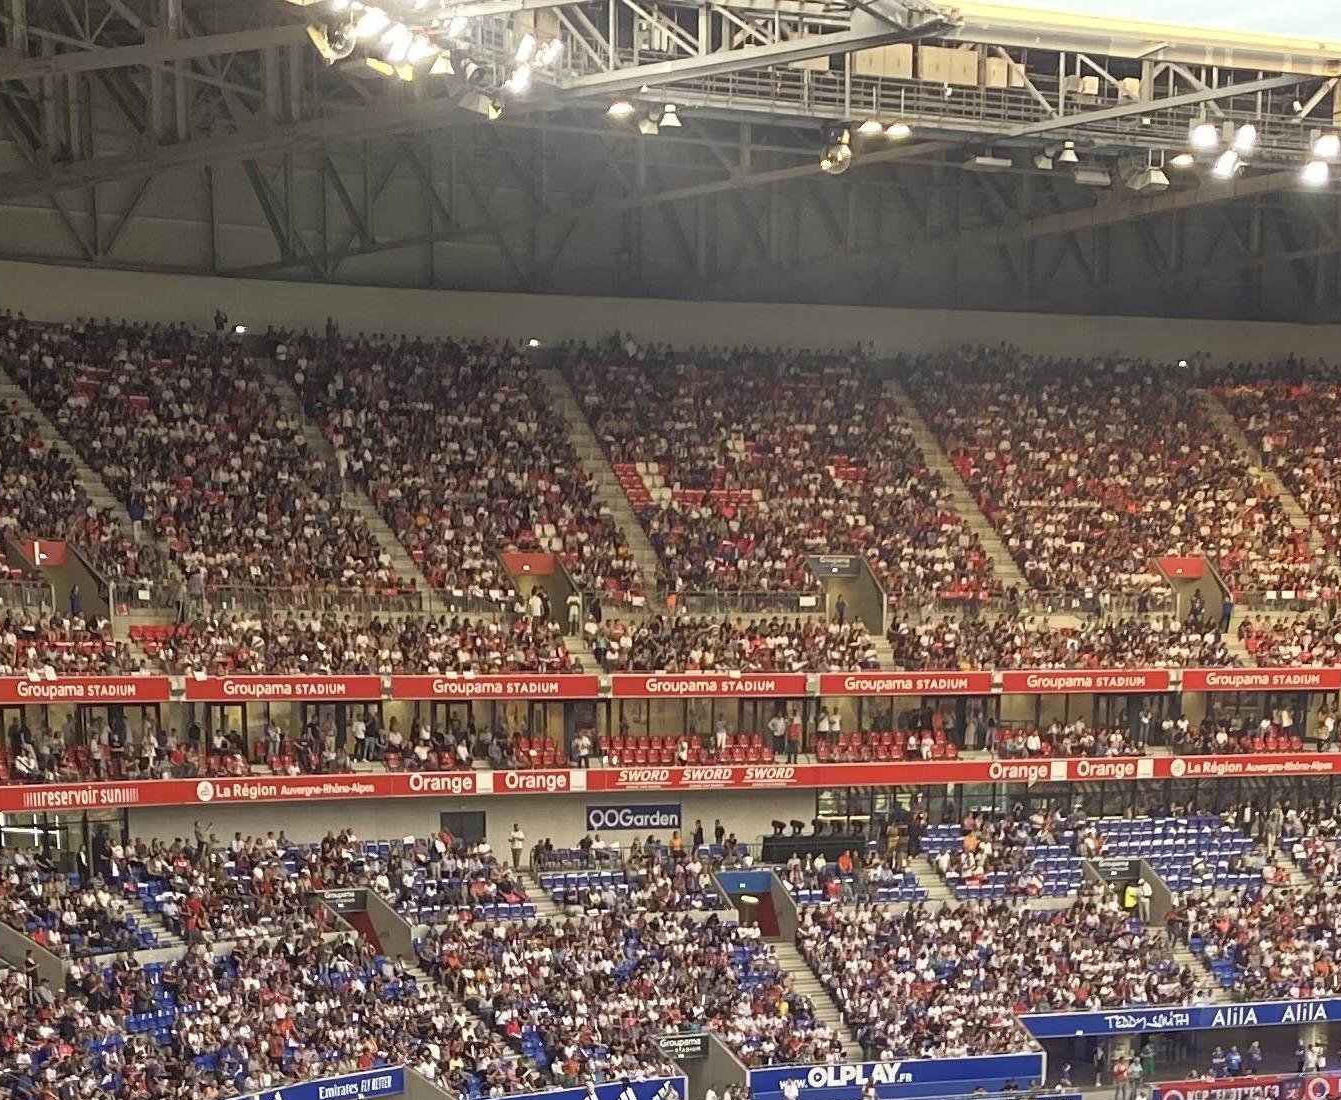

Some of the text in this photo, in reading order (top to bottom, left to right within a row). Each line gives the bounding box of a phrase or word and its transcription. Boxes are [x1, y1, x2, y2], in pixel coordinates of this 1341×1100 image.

[432, 679, 559, 697] Groupama STADIUM
[645, 678, 775, 694] Groupama STADIUM
[844, 676, 968, 692] Groupama STADIUM
[1026, 674, 1146, 690] Groupama STADIUM
[1206, 672, 1320, 687] Groupama STADIUM
[17, 681, 136, 700] Groupama STADIUM
[223, 680, 346, 698] Groupama STADIUM
[681, 769, 733, 781] SWORD
[744, 768, 795, 780] SWORD
[989, 762, 1048, 780] Orange
[1076, 761, 1135, 778] Orange
[1187, 761, 1201, 773] La
[1202, 759, 1243, 774] Région
[409, 773, 473, 793] Orange
[505, 772, 566, 791] Orange
[619, 770, 670, 782] SWORD
[216, 784, 231, 798] La
[233, 782, 277, 799] Région
[589, 809, 679, 829] OOGarden
[660, 1038, 701, 1049] Groupama
[319, 1083, 359, 1100] Emirates
